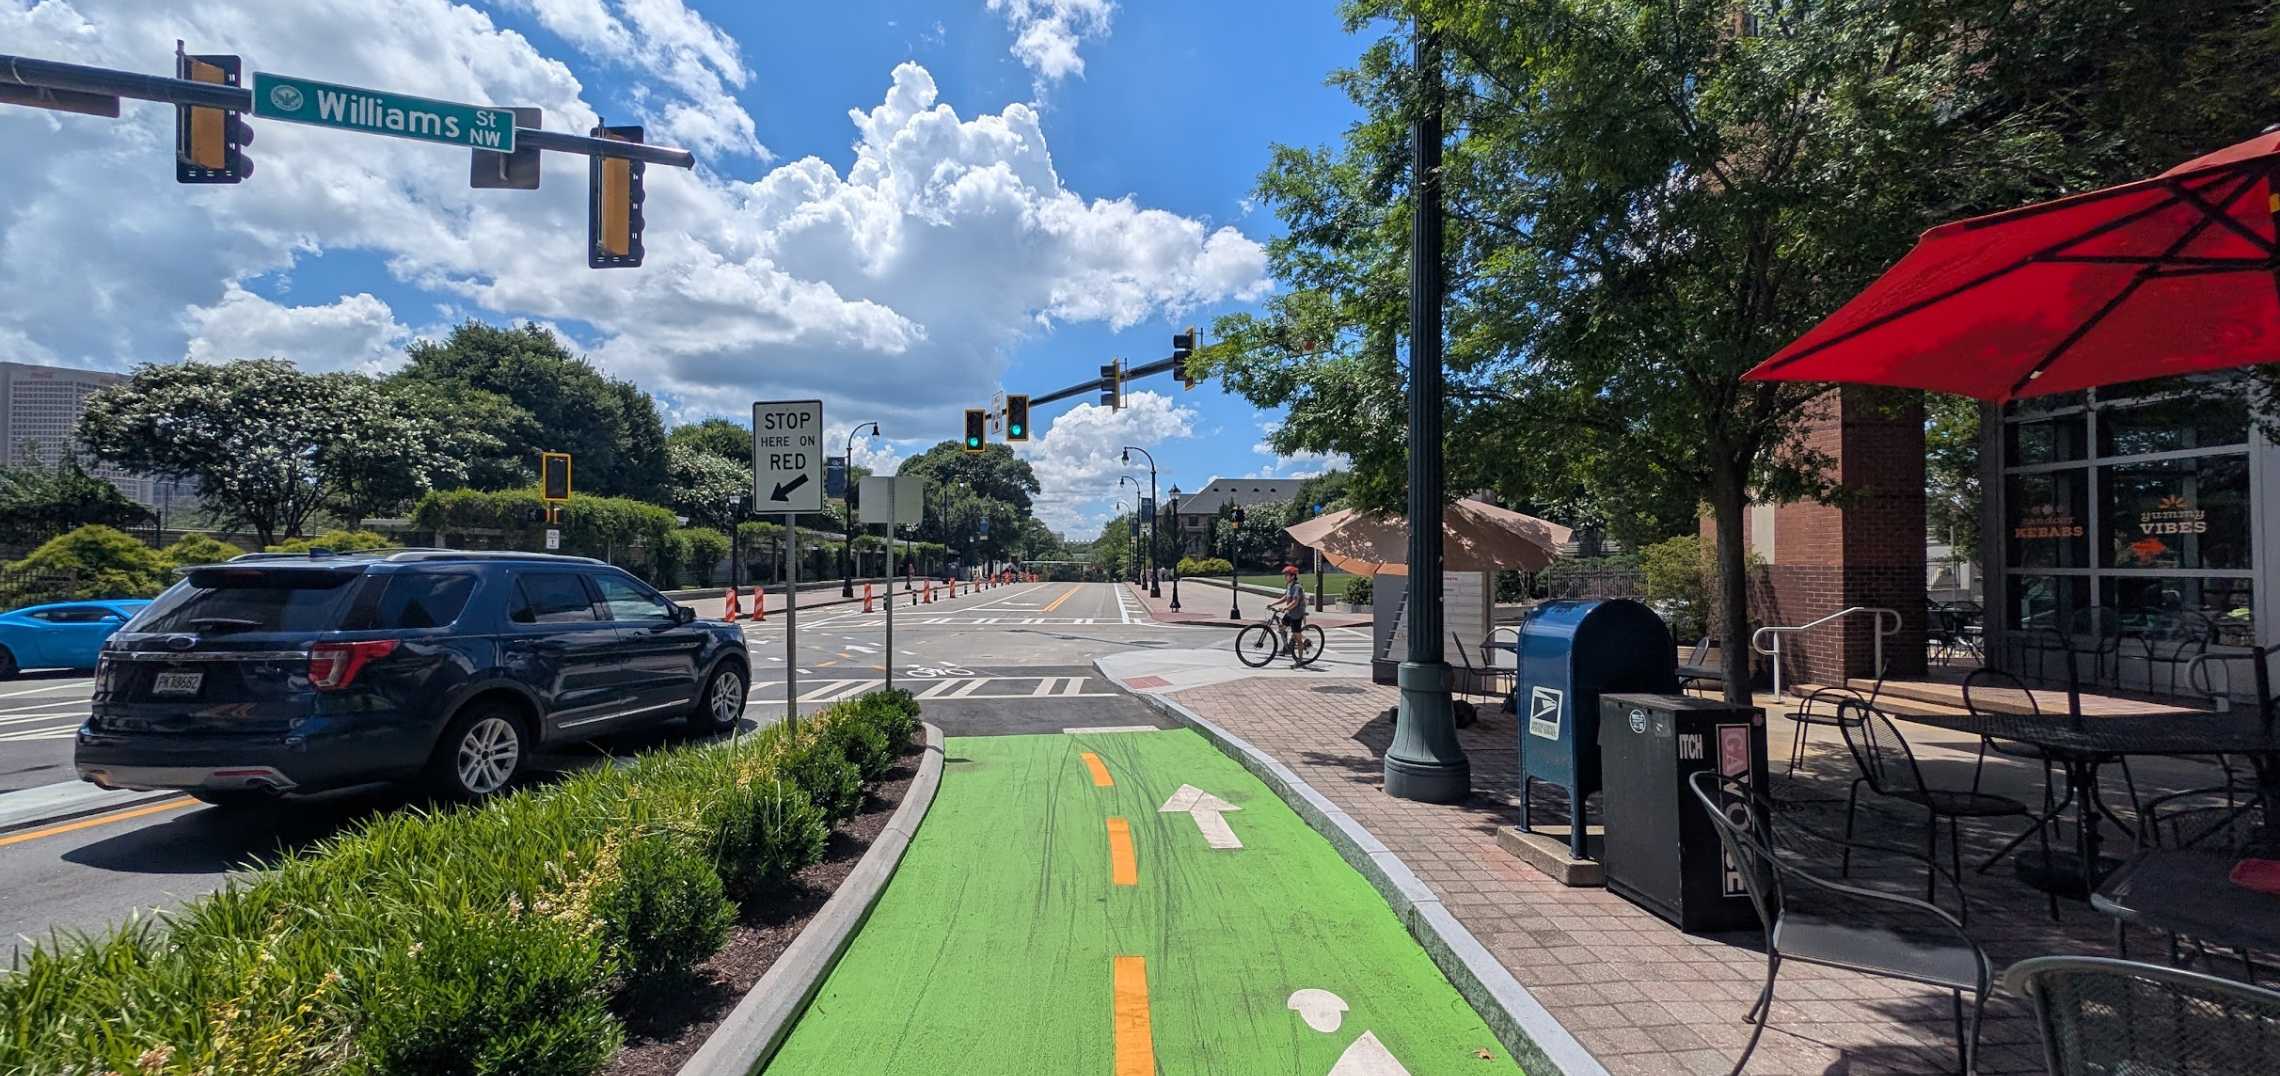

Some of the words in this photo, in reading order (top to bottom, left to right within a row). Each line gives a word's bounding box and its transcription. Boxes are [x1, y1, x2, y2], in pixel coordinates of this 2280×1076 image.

[317, 89, 460, 138] Williams
[475, 110, 496, 129] St
[469, 130, 501, 147] NW
[764, 412, 811, 430] STOP
[761, 436, 790, 448] HERE
[799, 435, 816, 447] ON
[770, 453, 807, 471] RED
[2140, 510, 2205, 522] yummy
[2015, 526, 2084, 538] KEBABS
[2139, 521, 2207, 535] VIBES
[1679, 734, 1704, 760] ITCH
